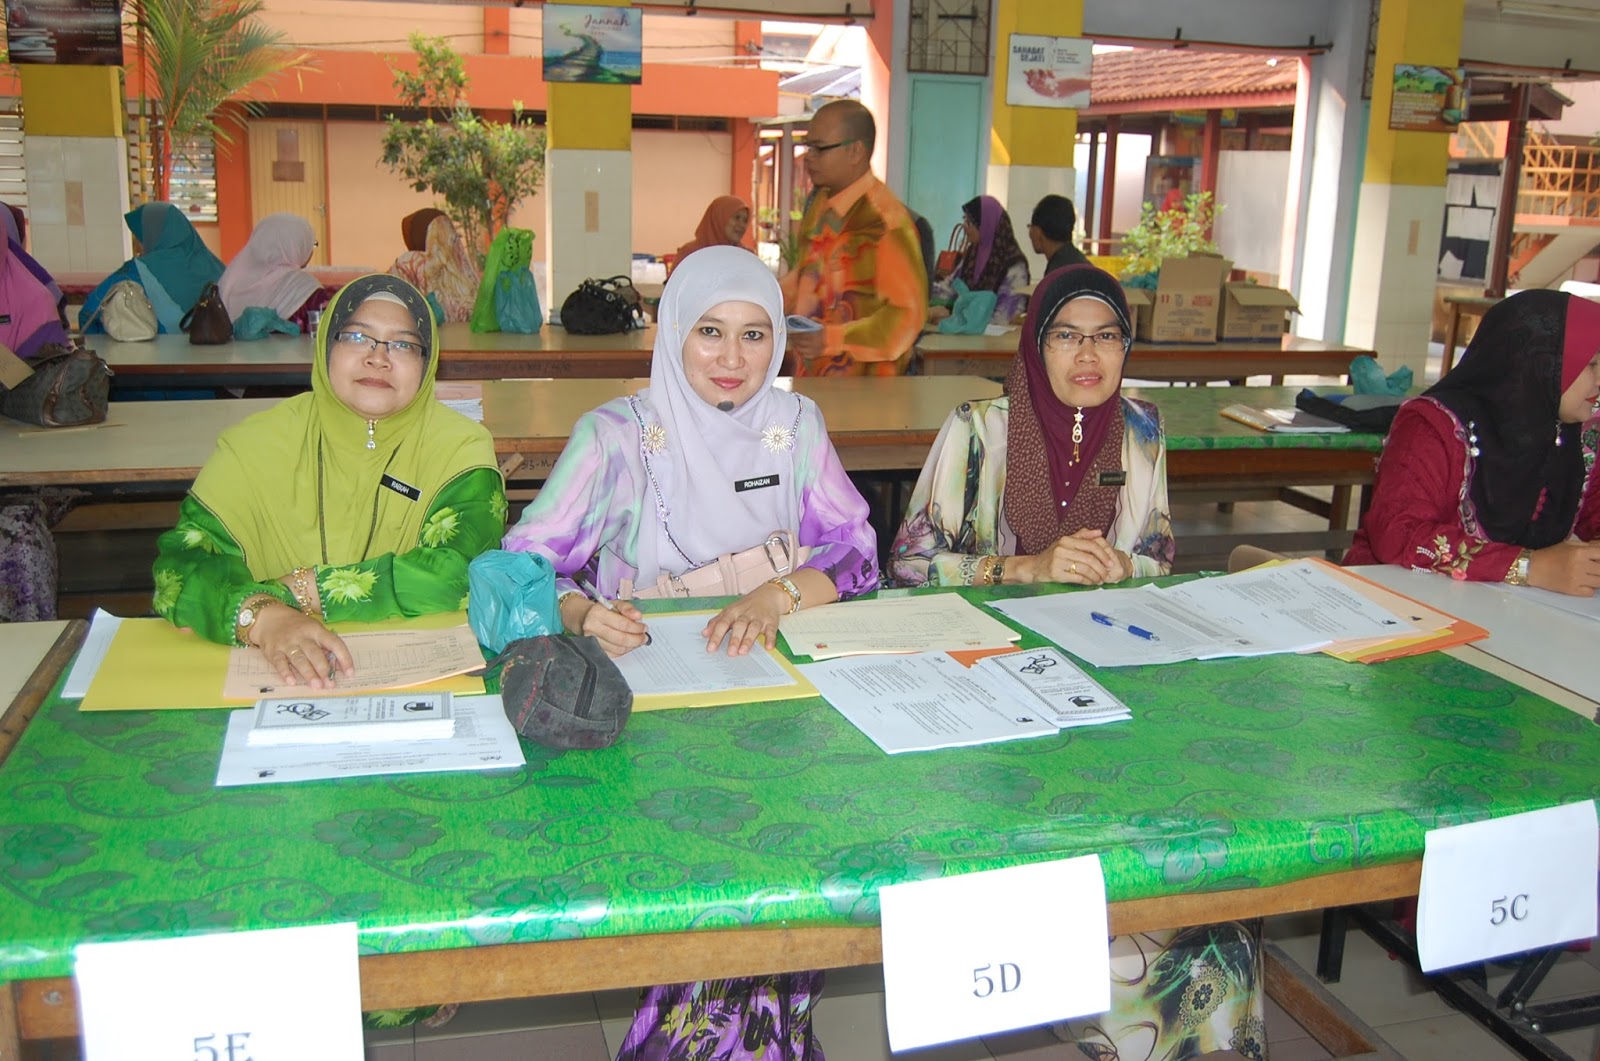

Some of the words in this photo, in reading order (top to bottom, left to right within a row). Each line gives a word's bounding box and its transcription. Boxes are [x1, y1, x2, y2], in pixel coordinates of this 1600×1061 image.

[584, 14, 630, 28] Jannah
[1013, 46, 1045, 54] SAHABAT
[391, 480, 410, 494] RABIAH
[743, 478, 771, 488] ROHAIZAN
[1490, 894, 1530, 926] 5C
[973, 962, 1022, 998] 5D
[193, 1032, 255, 1061] 5E
